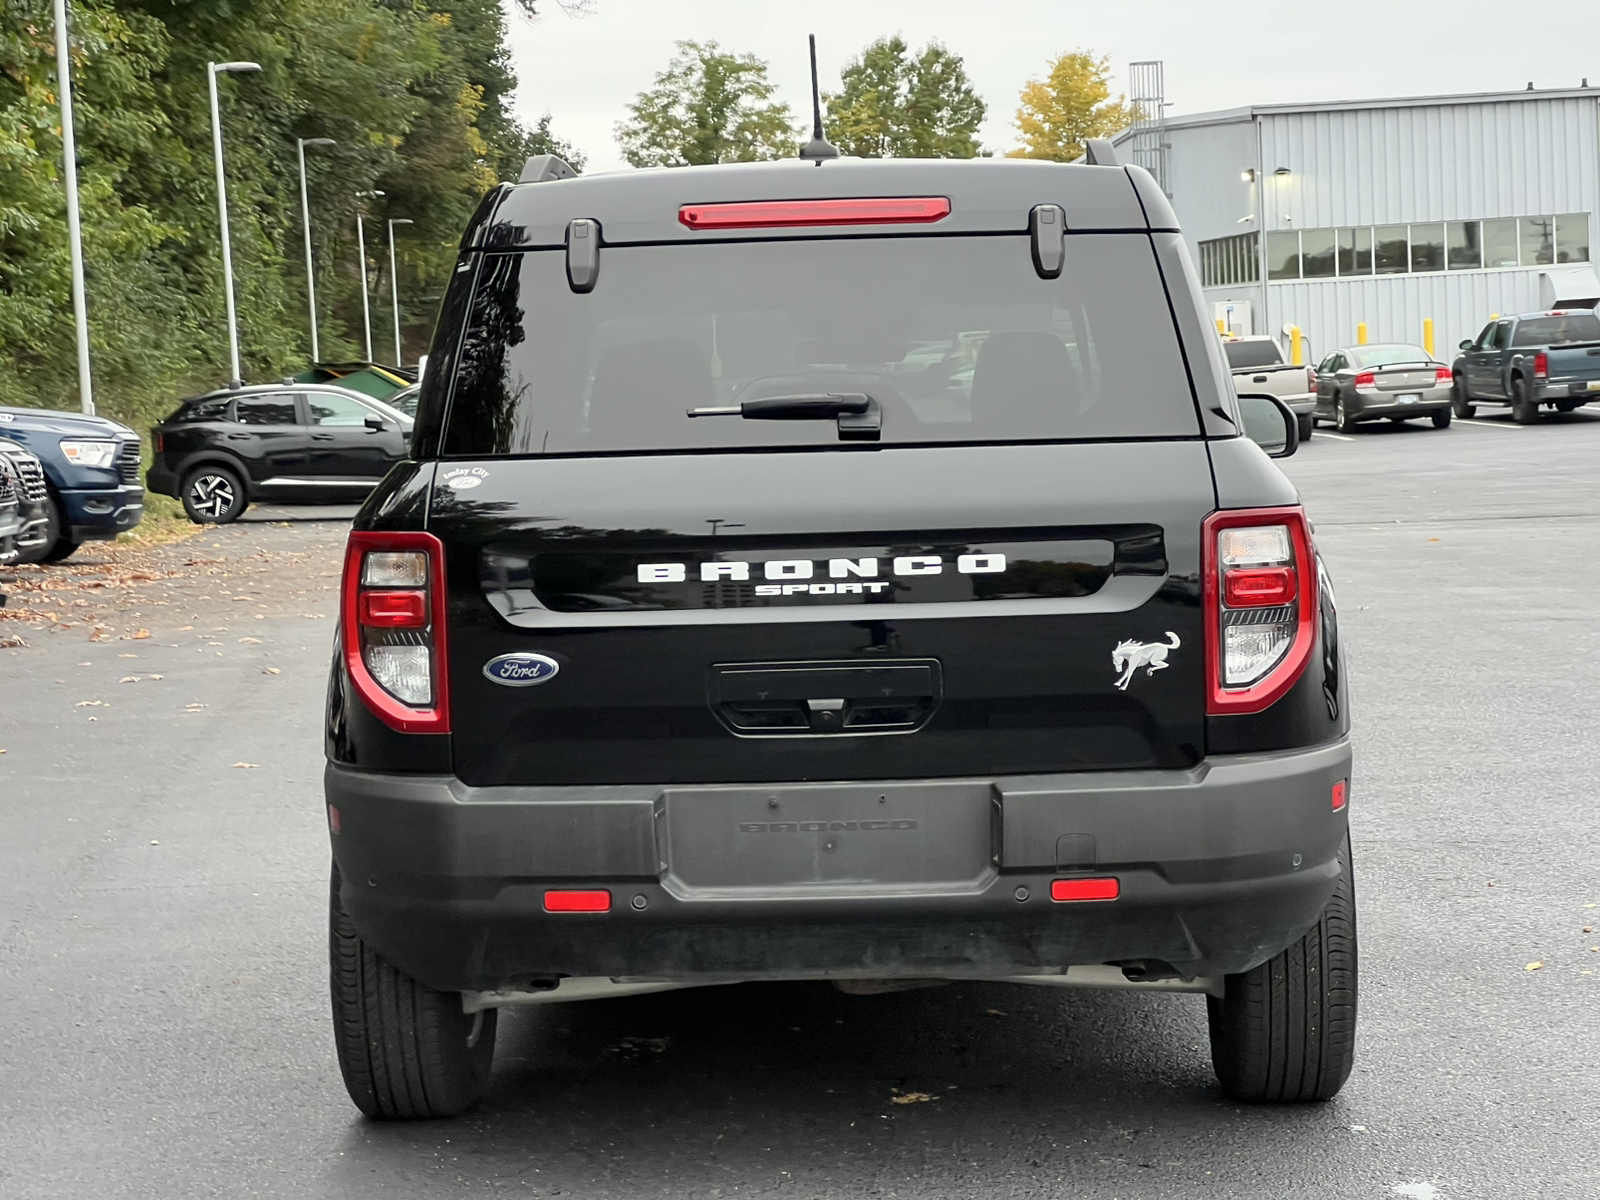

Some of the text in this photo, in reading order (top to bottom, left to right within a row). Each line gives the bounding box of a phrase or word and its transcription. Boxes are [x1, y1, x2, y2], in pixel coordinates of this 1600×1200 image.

[471, 467, 490, 479] City
[637, 553, 1007, 583] BRONCO
[754, 581, 890, 596] SPORT
[500, 660, 541, 678] Ford
[739, 818, 918, 833] BRONCO
